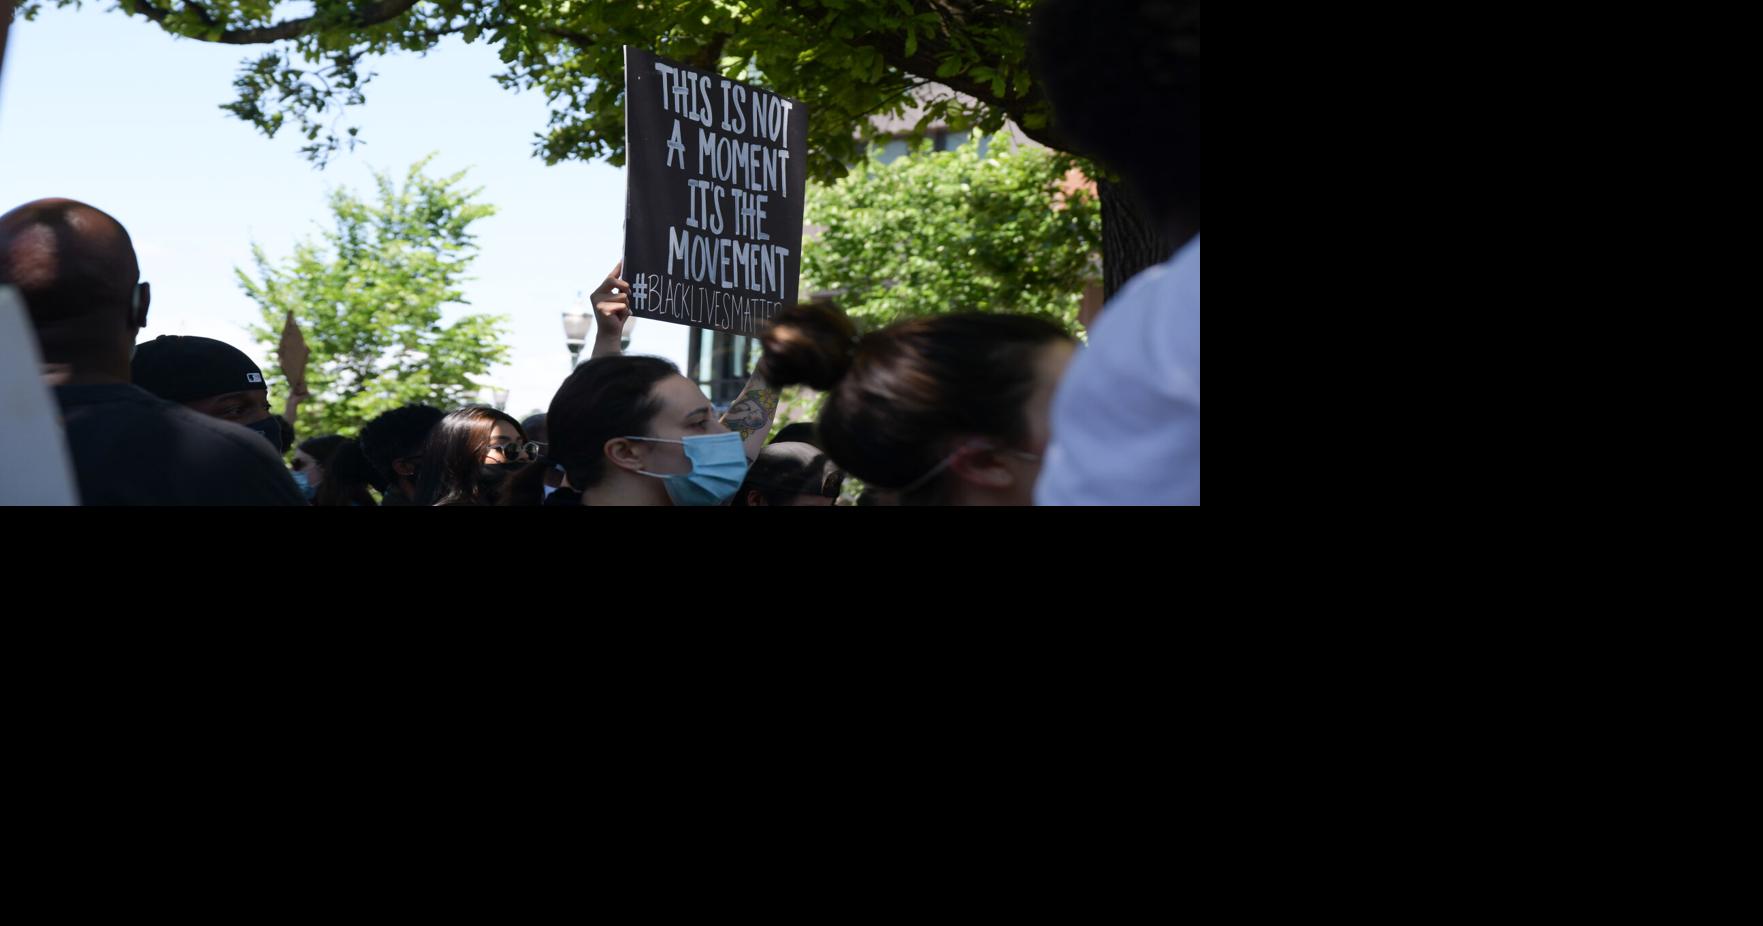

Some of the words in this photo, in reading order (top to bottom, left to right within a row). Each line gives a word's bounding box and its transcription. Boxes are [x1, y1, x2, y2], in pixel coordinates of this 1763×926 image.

[655, 62, 712, 127] THIS
[721, 80, 746, 134] IS
[752, 92, 792, 148] NOT
[667, 119, 685, 170] A
[699, 128, 790, 198] MOMENT
[686, 179, 725, 235] IT'S
[731, 188, 770, 240] THE
[668, 226, 789, 299] MOVEMENT
